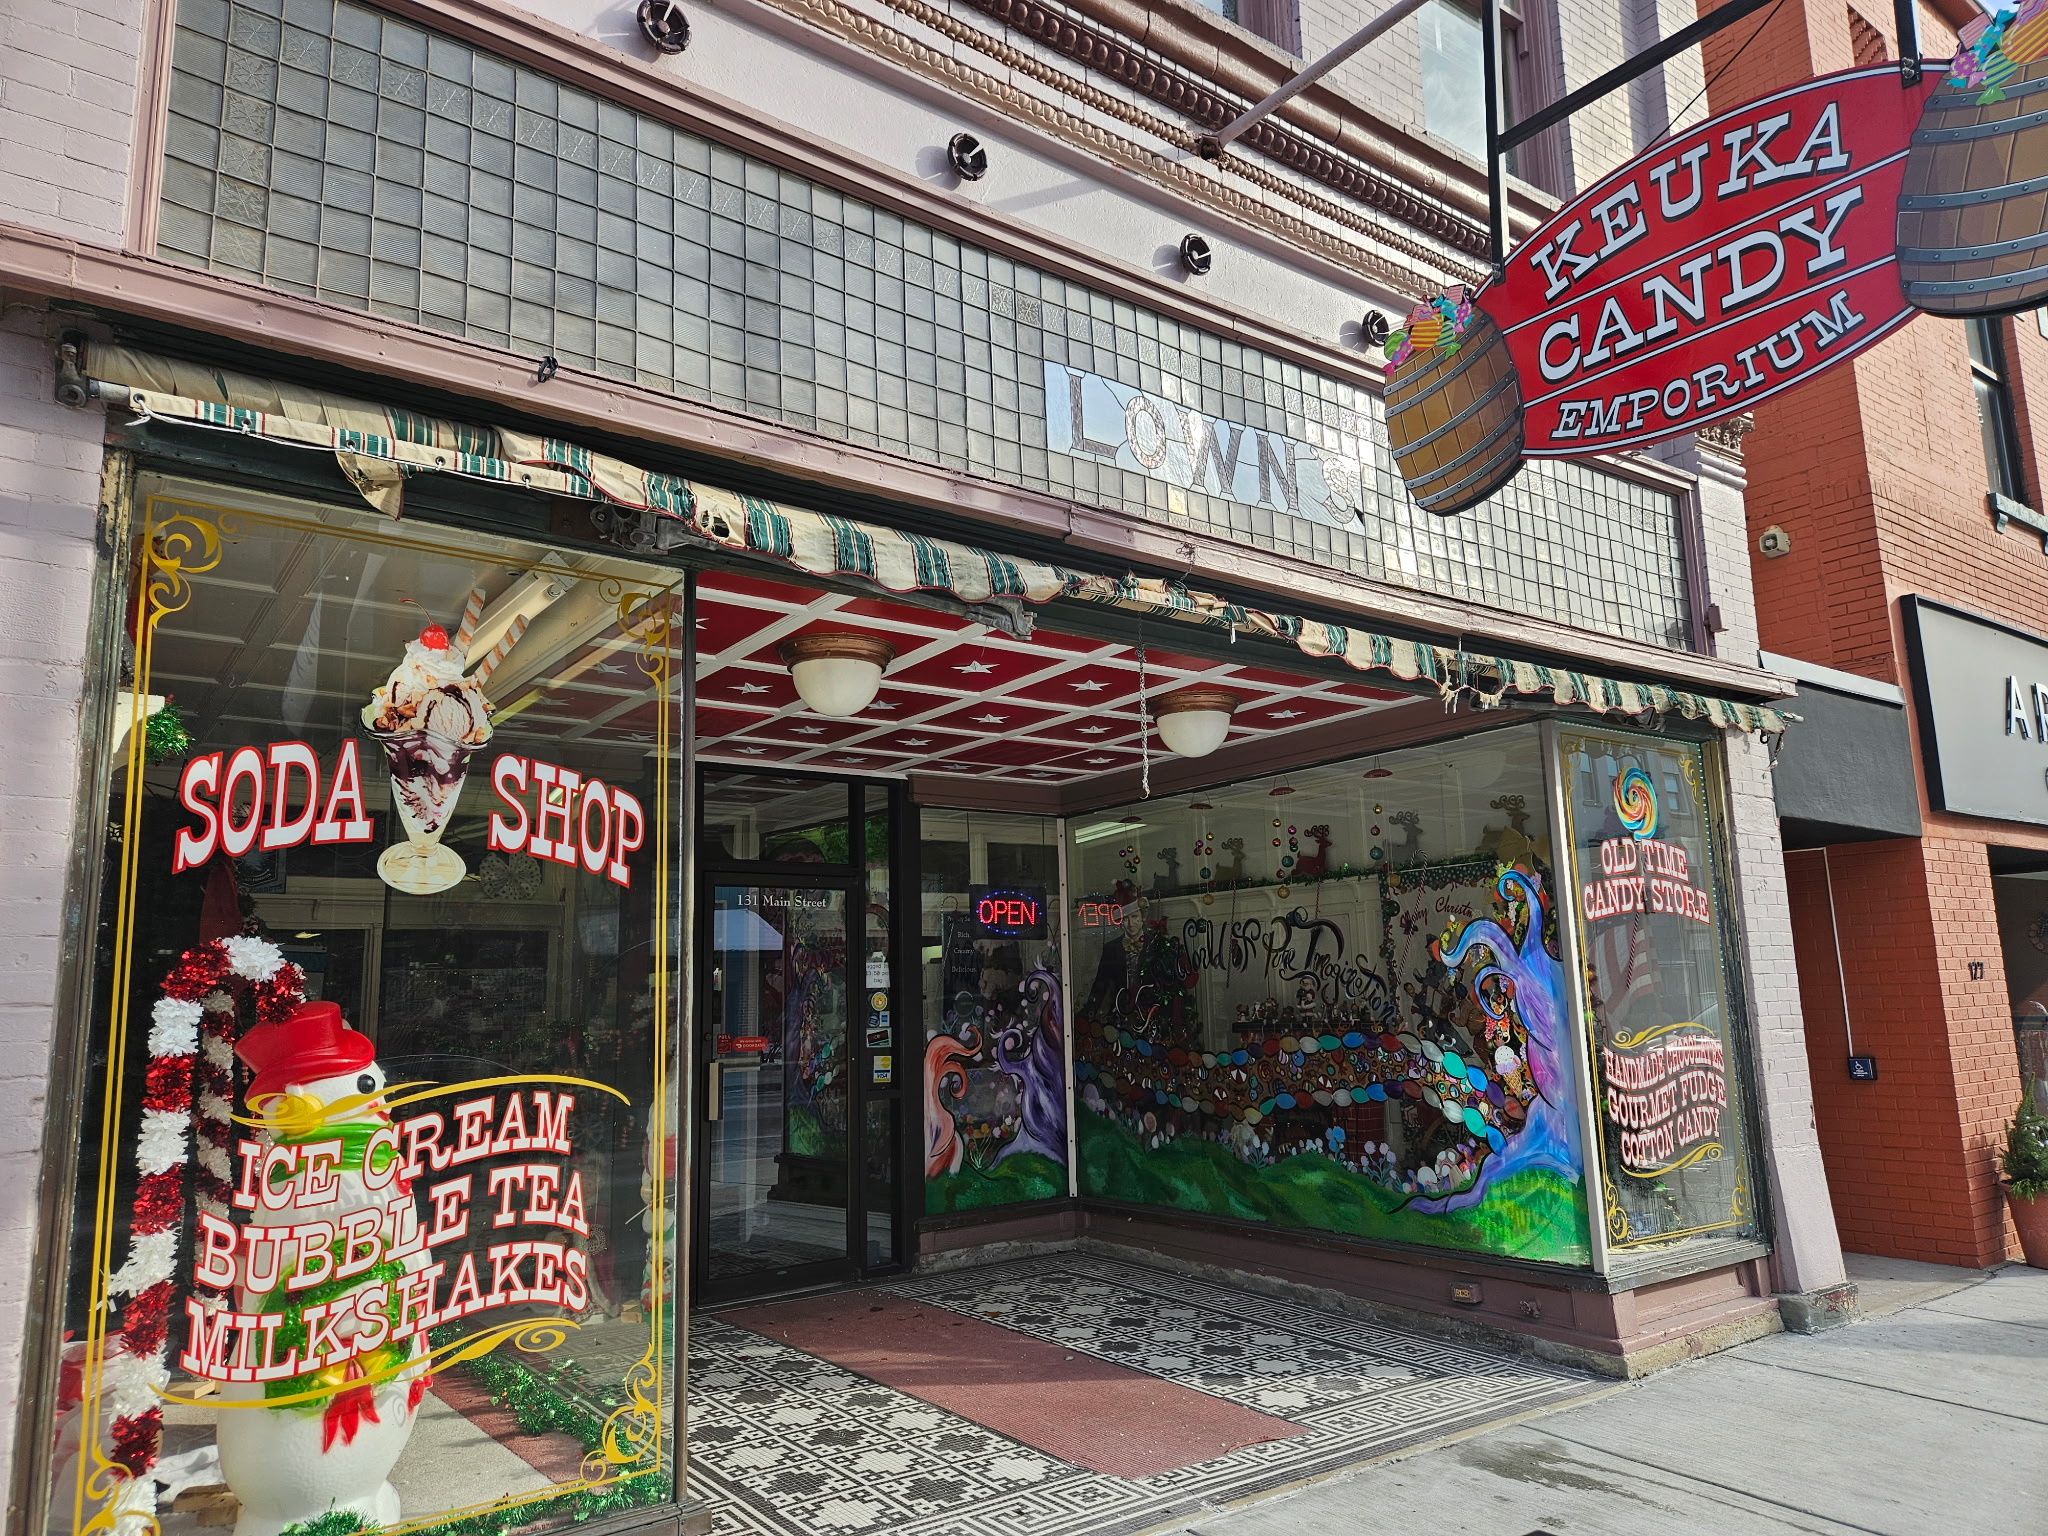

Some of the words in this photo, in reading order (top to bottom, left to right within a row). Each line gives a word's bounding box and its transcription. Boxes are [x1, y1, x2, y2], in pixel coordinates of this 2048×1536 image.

[1530, 102, 1851, 303] KEUKA
[1538, 185, 1863, 382] CANDY
[1550, 290, 1865, 439] EMPORIUM
[172, 738, 374, 874] SODA
[487, 753, 645, 888] SHOP
[737, 894, 759, 906] 131
[762, 894, 790, 907] Main
[795, 895, 826, 908] Street
[1584, 876, 1646, 921] CANDY
[1651, 878, 1711, 924] STORE
[1601, 837, 1637, 876] OLD
[1641, 838, 1689, 882] TIME
[979, 900, 1036, 925] OPEN
[1603, 1045, 1666, 1090] HANDMADE
[1607, 1079, 1677, 1129] GOURMET
[1679, 1070, 1728, 1109] FUDGE
[233, 1138, 343, 1210] ICE
[362, 1090, 575, 1190] CREAM
[1620, 1119, 1675, 1167] COTTON
[1677, 1106, 1720, 1146] CANDY
[194, 1173, 472, 1294] BUBBLE
[488, 1164, 589, 1236] TEA
[180, 1241, 590, 1382] MILKSHAKES
